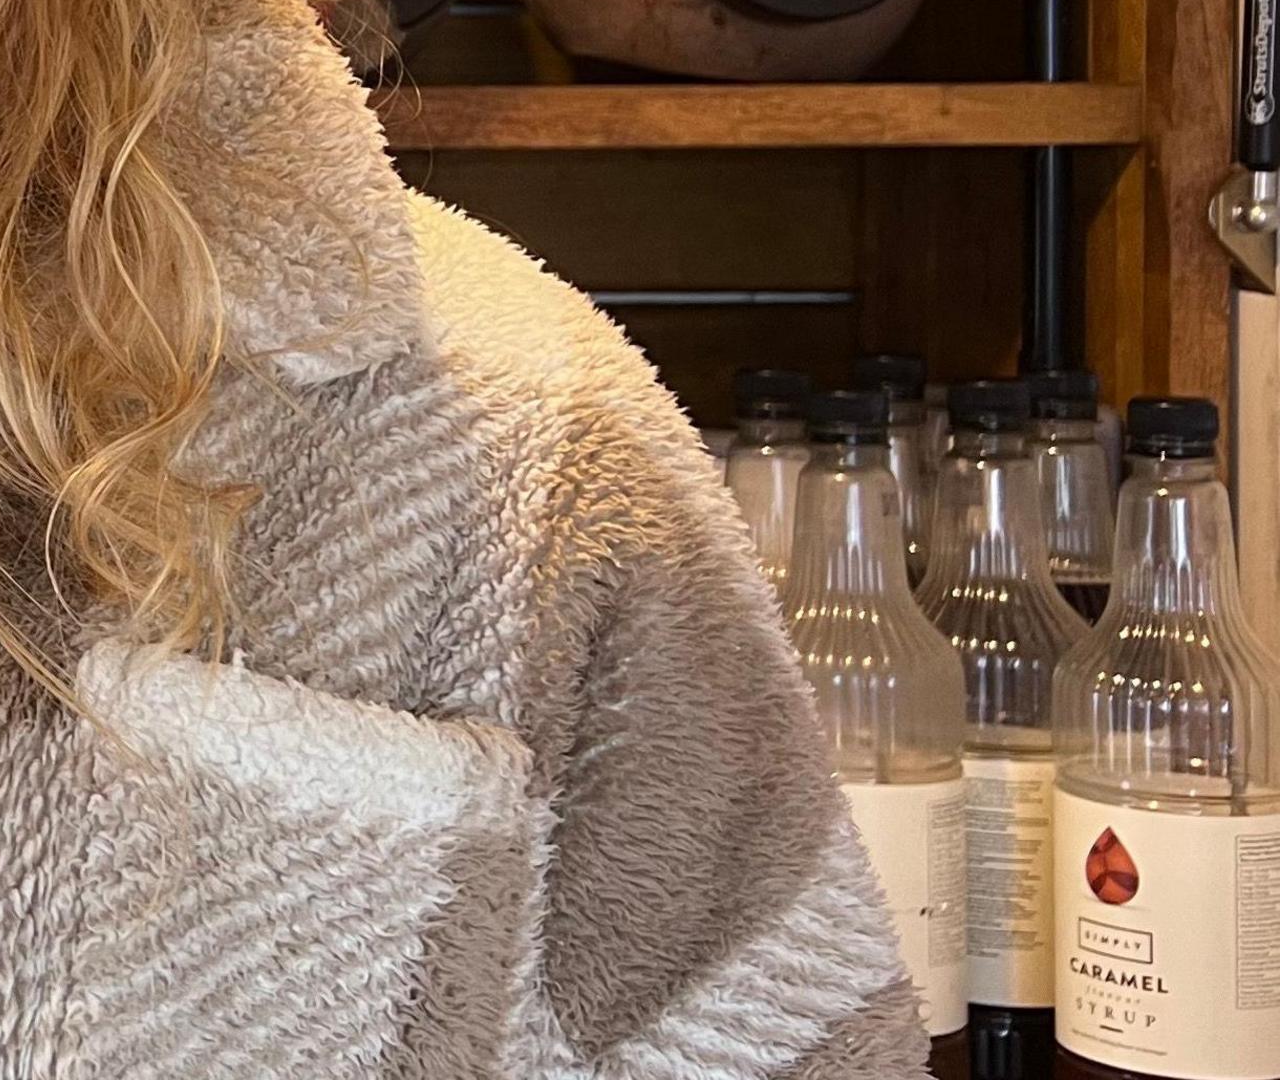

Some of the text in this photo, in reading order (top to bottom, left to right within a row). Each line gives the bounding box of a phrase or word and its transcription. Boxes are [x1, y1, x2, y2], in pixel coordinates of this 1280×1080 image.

[1084, 930, 1142, 951] SIMPLY
[1069, 957, 1169, 994] CARAMEL
[1075, 996, 1157, 1028] SYRUP
